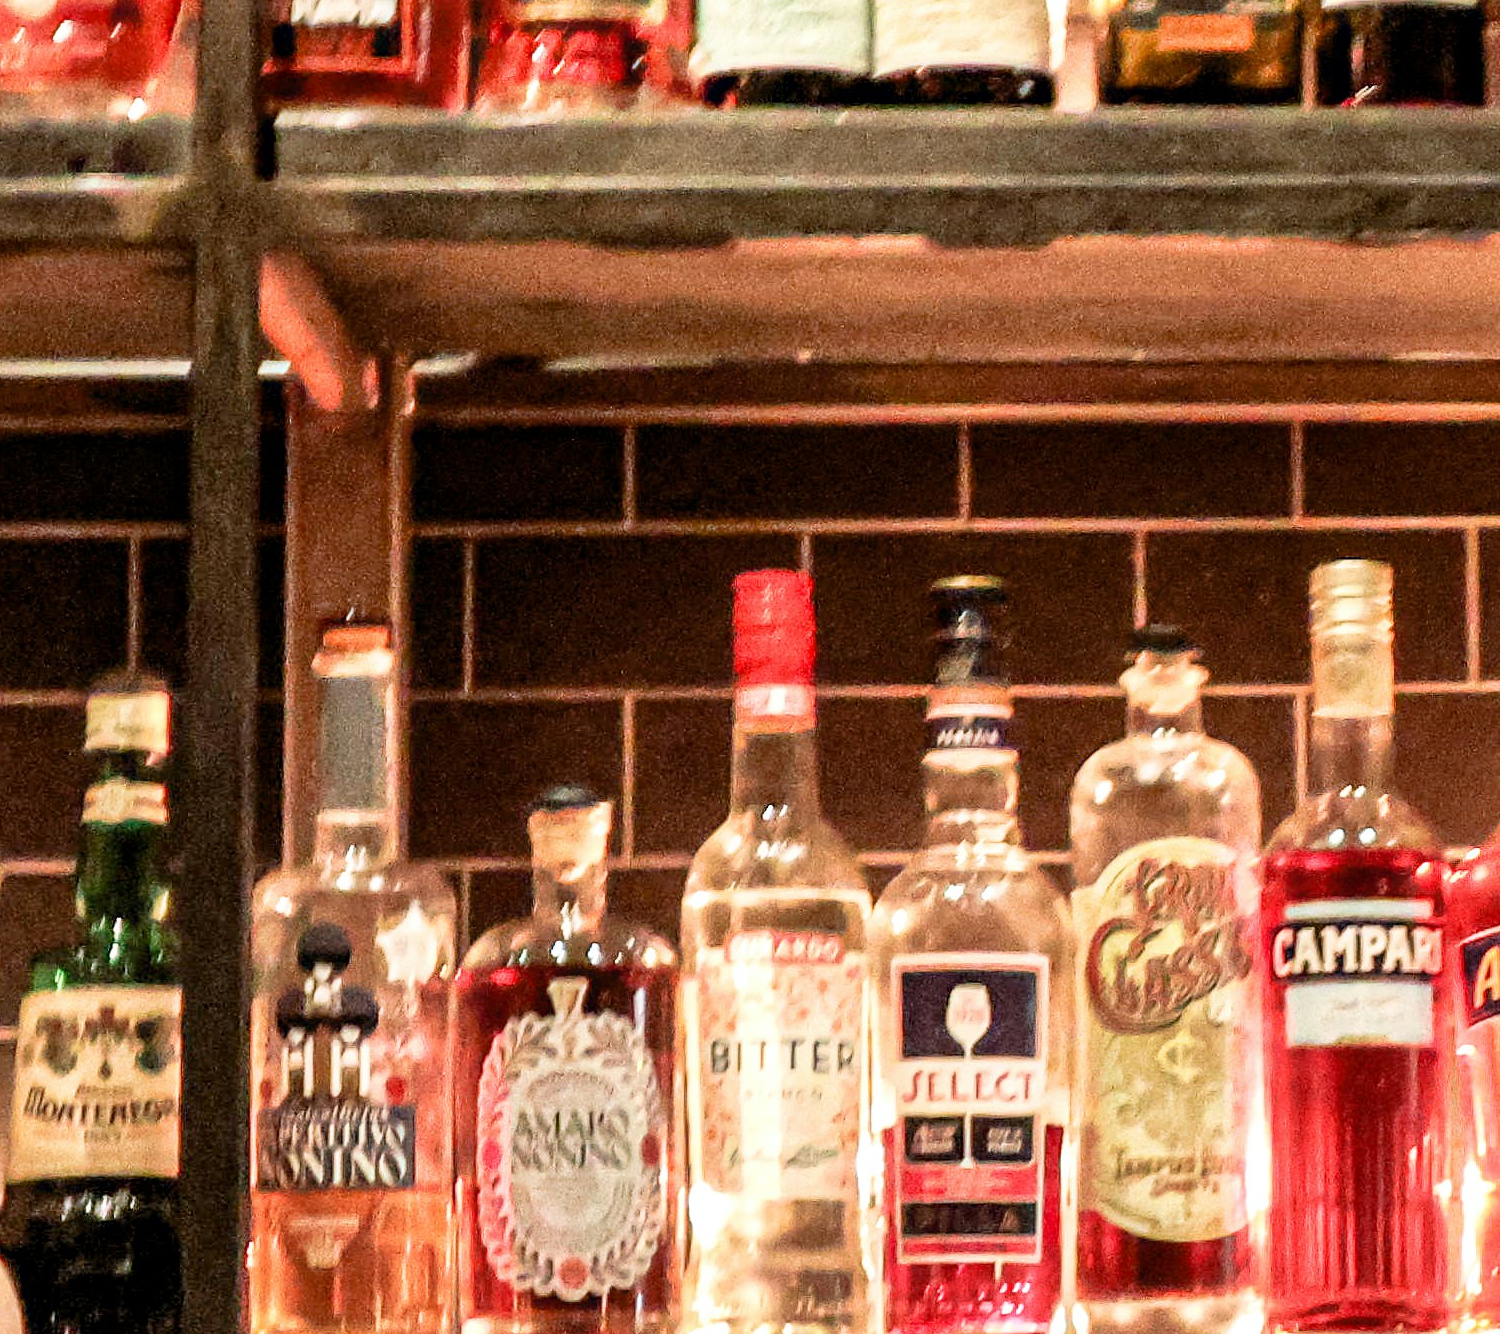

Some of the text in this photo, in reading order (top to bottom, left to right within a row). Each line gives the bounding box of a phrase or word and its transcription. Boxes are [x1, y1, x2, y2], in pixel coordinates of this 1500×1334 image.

[1272, 924, 1444, 979] CAMPARI
[710, 1038, 856, 1076] BITTER
[902, 1068, 1034, 1104] SELECT
